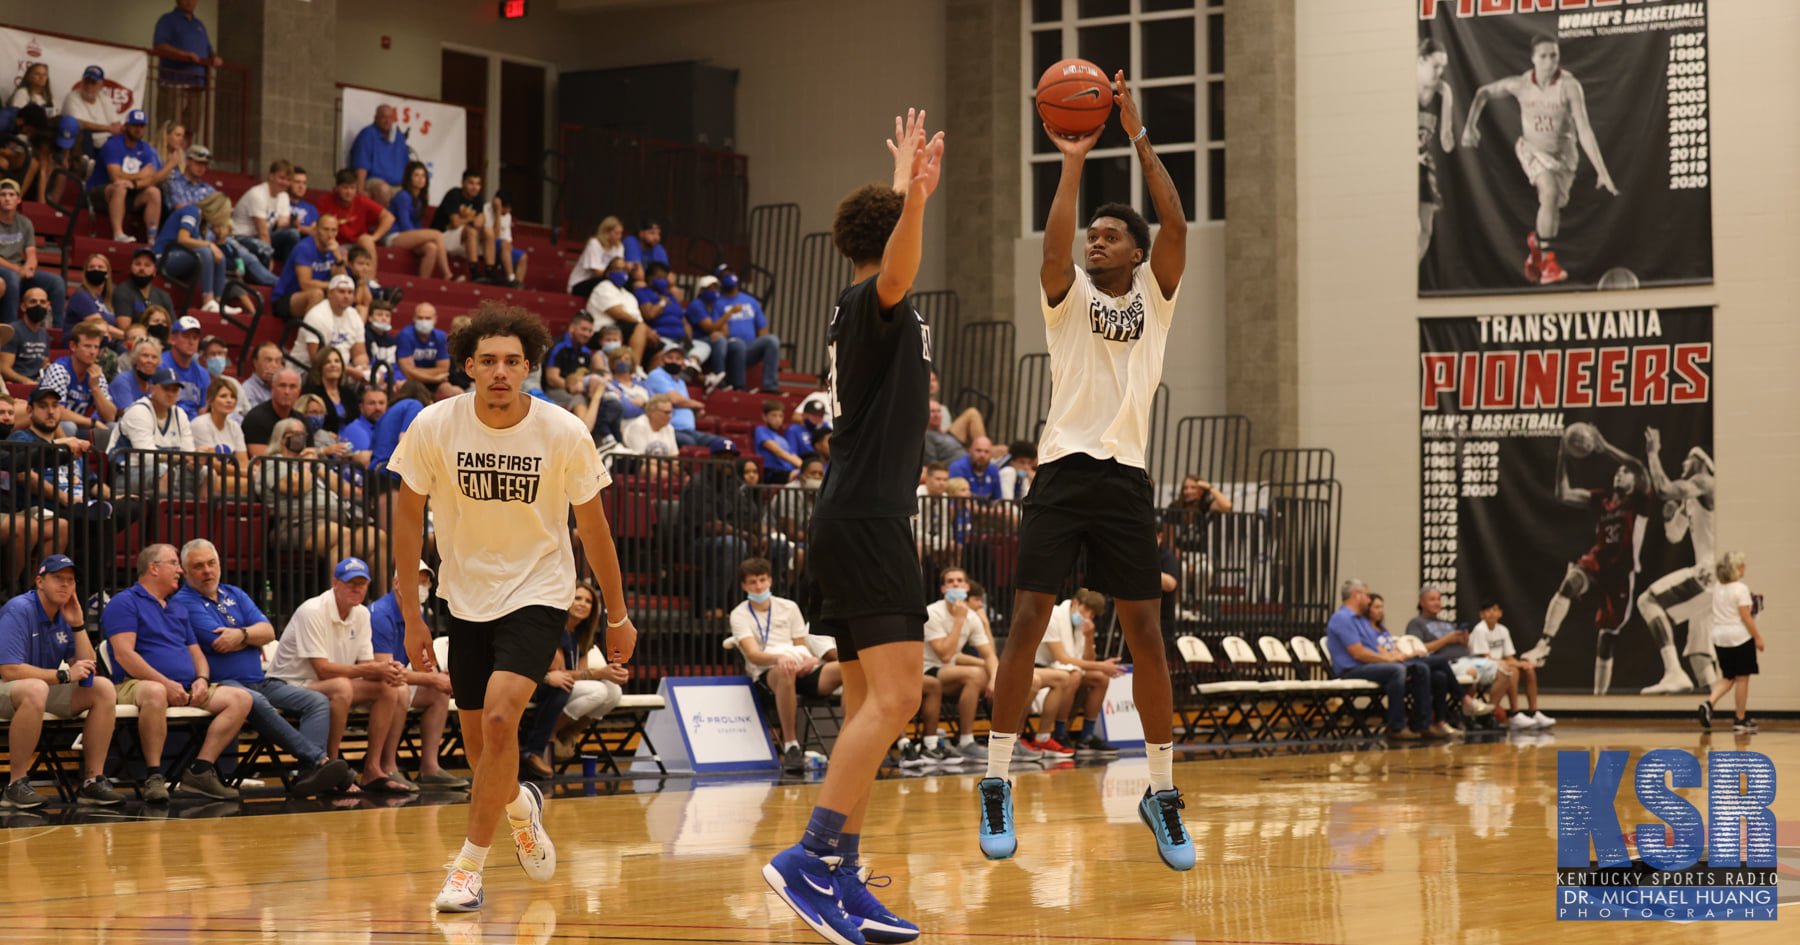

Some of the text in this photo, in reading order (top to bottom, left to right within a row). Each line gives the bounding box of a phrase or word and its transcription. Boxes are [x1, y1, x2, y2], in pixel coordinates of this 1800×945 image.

[1558, 10, 1622, 29] WOMEN'S
[1624, 2, 1704, 24] BASKETBALL
[1669, 32, 1705, 47] 1997
[1669, 46, 1706, 61] 1999
[1666, 61, 1706, 76] 2000
[1666, 75, 1706, 90] 2002
[1667, 89, 1706, 104] 2003
[1668, 103, 1707, 118] 2007
[1668, 117, 1707, 133] 2009
[1669, 131, 1707, 147] 2014
[1669, 145, 1708, 161] 2015
[1669, 160, 1707, 175] 2019
[1669, 174, 1708, 189] 2020
[1477, 309, 1662, 343] TRANSYLVANIA
[1421, 342, 1711, 410] PIONEERS
[1422, 413, 1565, 431] MEN'S BASKETBALL
[1424, 441, 1456, 454] 1963
[1463, 441, 1499, 454] 2009
[457, 451, 542, 472] FANS FIRST
[1462, 455, 1499, 468] 2012
[1462, 469, 1499, 482] 2013
[460, 472, 538, 502] FAN FEST
[1424, 483, 1458, 496] 1970
[1461, 483, 1498, 497] 2020
[1424, 497, 1458, 510] 1972
[1424, 511, 1458, 524] 1973
[1424, 553, 1457, 566] 1977
